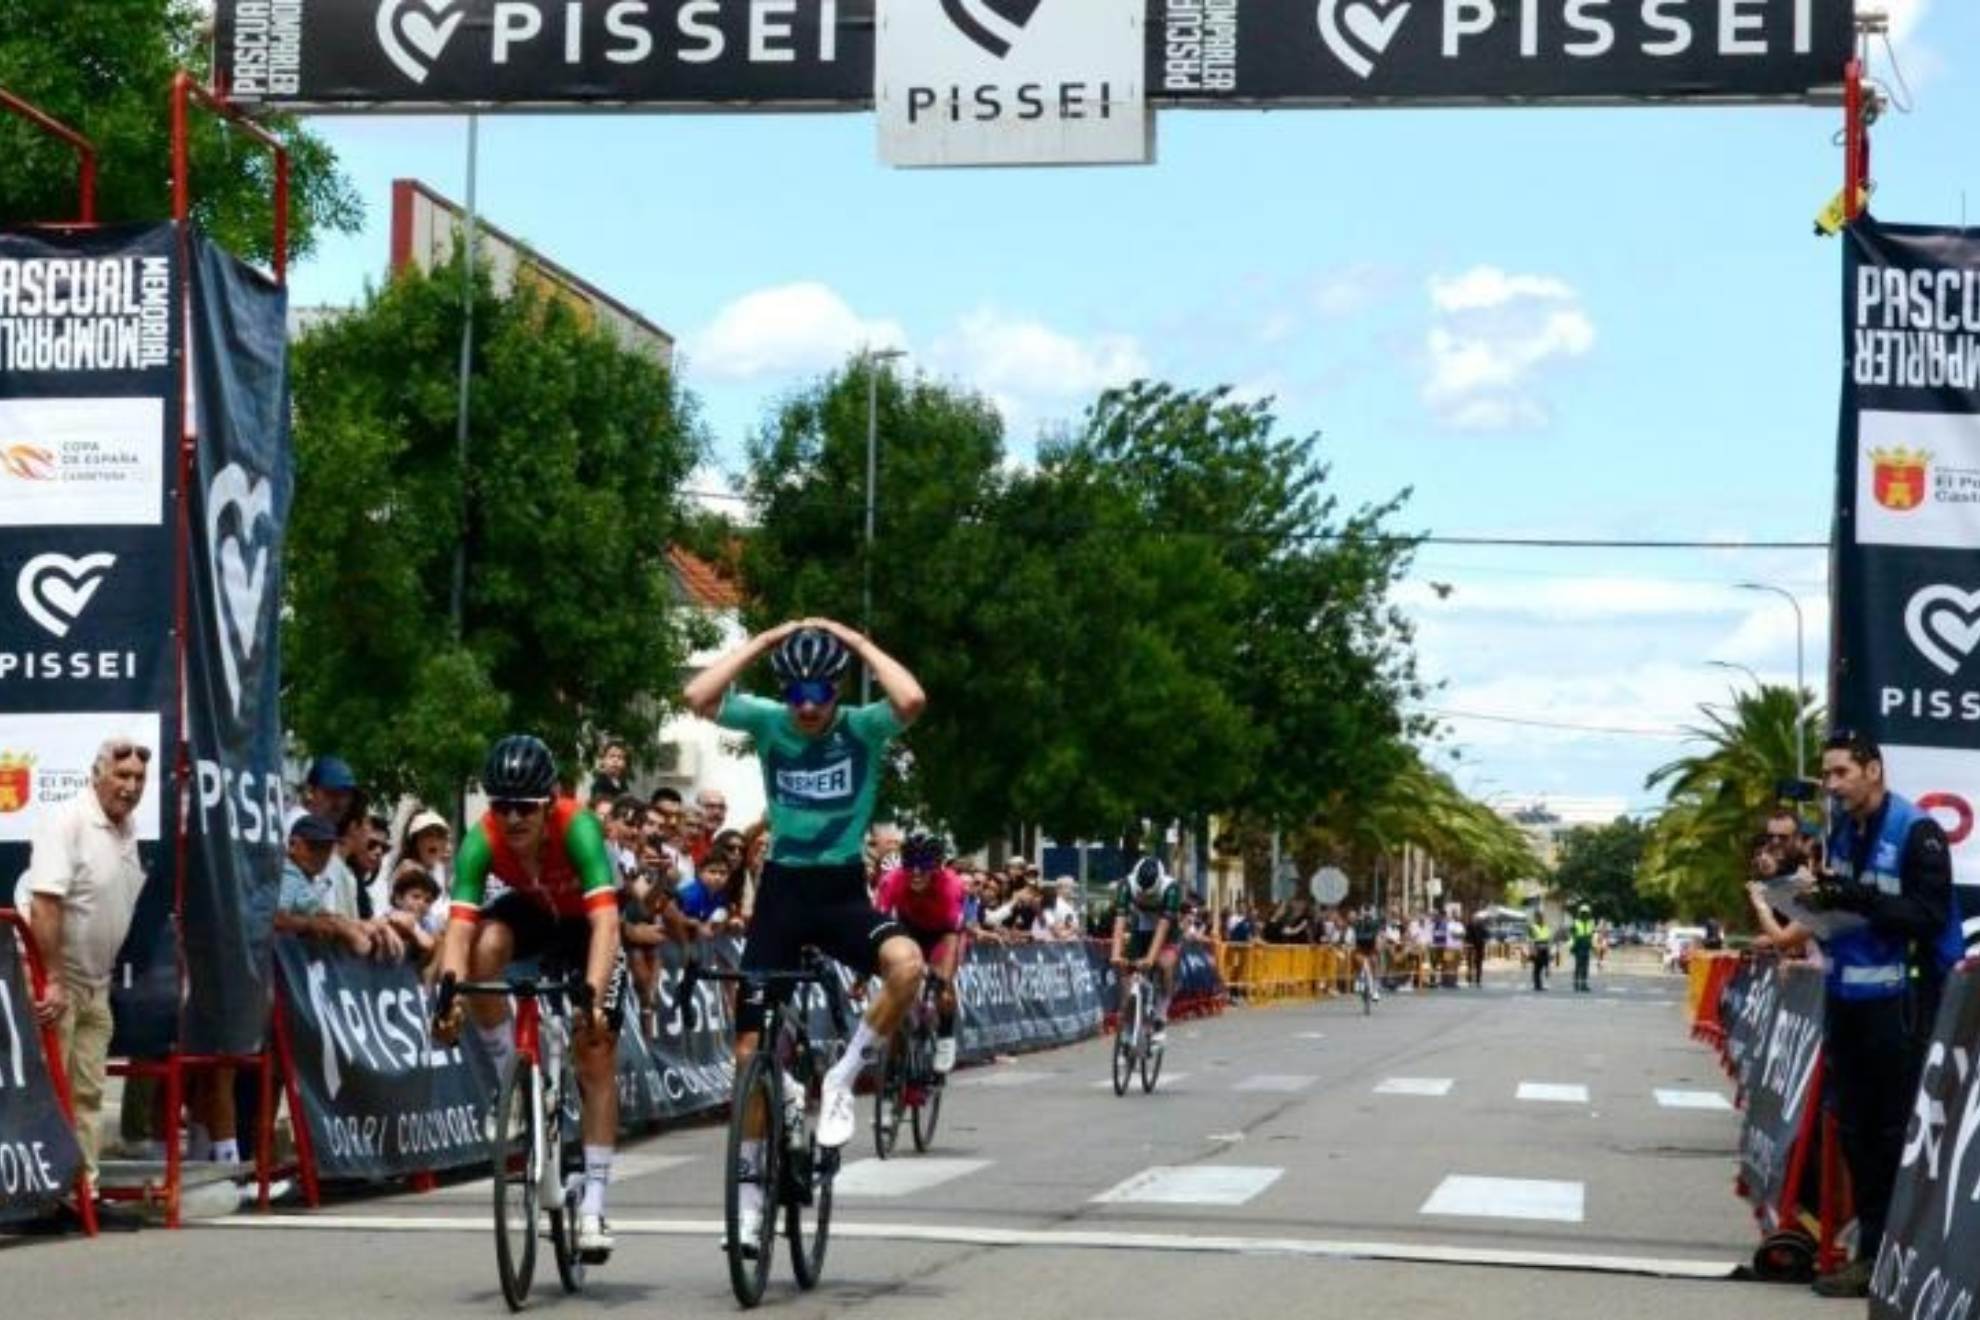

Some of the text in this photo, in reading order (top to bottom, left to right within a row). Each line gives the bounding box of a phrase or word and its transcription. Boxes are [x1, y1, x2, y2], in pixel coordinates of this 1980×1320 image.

[492, 1, 836, 64] PISSEI
[1441, 0, 1812, 57] PISSEI
[907, 82, 1110, 122] PISSEI
[140, 256, 169, 368] MEMORIAL
[0, 652, 136, 679] PISSEI
[1881, 687, 1980, 720] PISS
